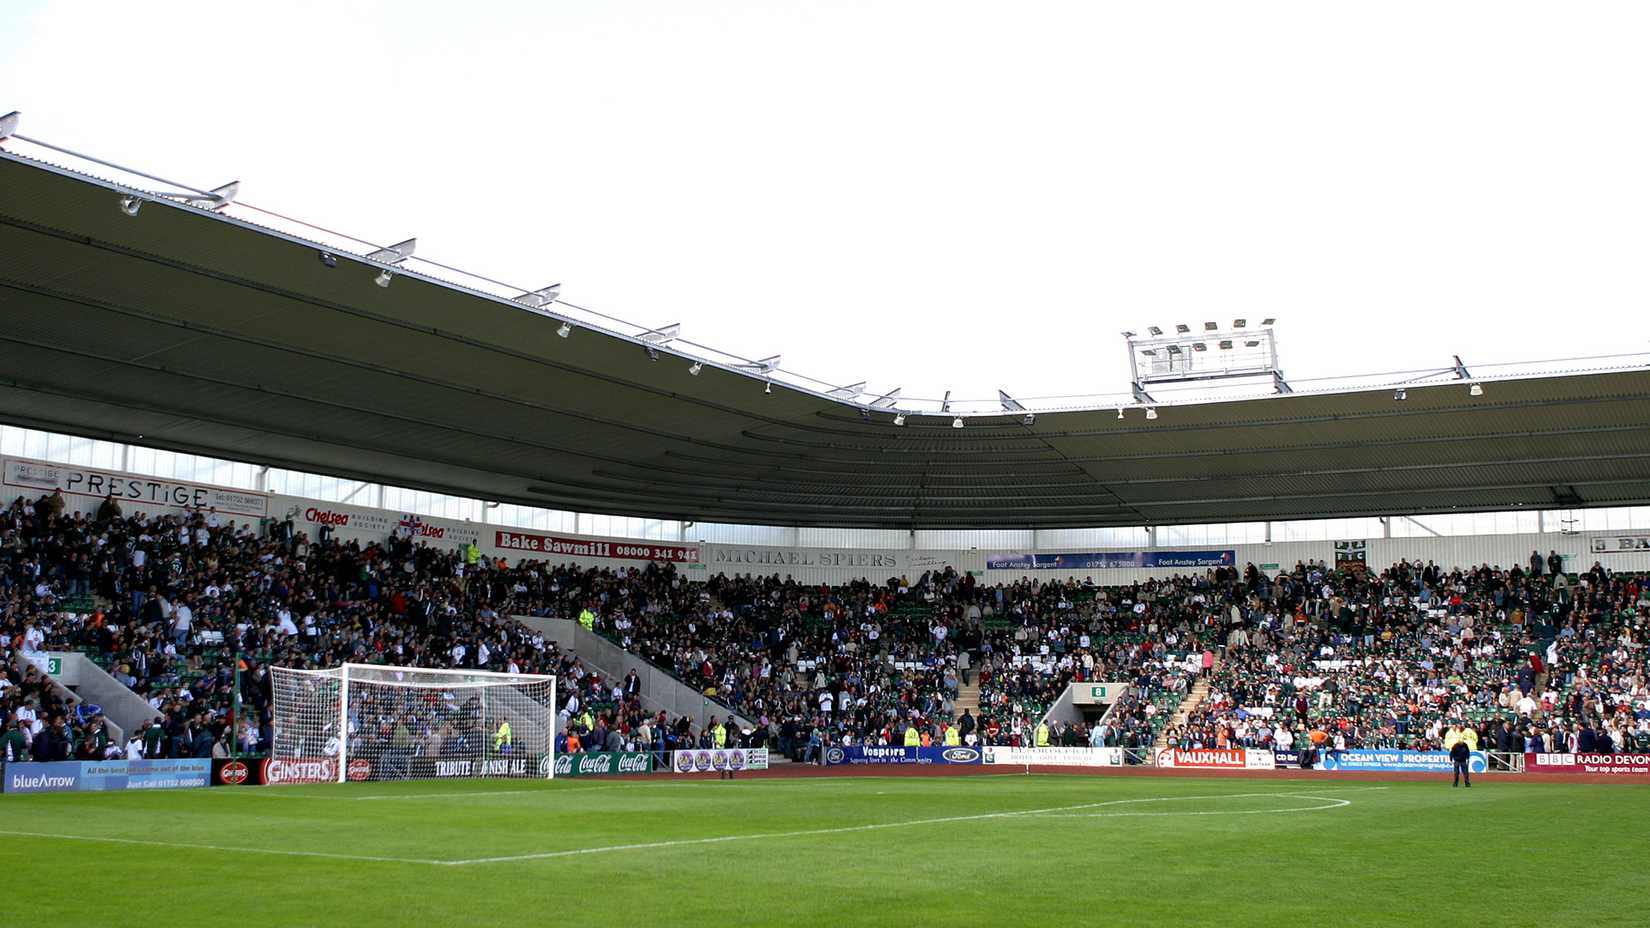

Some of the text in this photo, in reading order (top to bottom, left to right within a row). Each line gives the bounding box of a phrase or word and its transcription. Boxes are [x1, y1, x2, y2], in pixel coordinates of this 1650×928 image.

[305, 507, 349, 526] Chelsea
[351, 513, 388, 524] BUILDING
[449, 534, 474, 543] SOCIET
[500, 532, 697, 560] Bake Sawmill 08000 341 941
[715, 550, 814, 566] MICHAEL
[819, 553, 896, 567] SPIERS
[1357, 552, 1363, 560] C
[1009, 561, 1031, 569] Anstey
[1158, 557, 1223, 568] Foot Anstey Sargent
[49, 660, 56, 673] 3
[1095, 687, 1102, 696] 8
[951, 751, 971, 760] Ford
[1175, 751, 1244, 765] VAUXHALL
[1276, 753, 1287, 761] CD
[1340, 754, 1454, 763] OCEAN VIEW PROPERTI
[1539, 755, 1573, 764] BBC
[1577, 755, 1612, 764] RADIO
[267, 759, 331, 782] GINSTERS
[435, 760, 472, 776] TRIBUTE
[510, 759, 527, 774] ALE
[1611, 765, 1630, 773] sports
[13, 774, 75, 788] blueArrow
